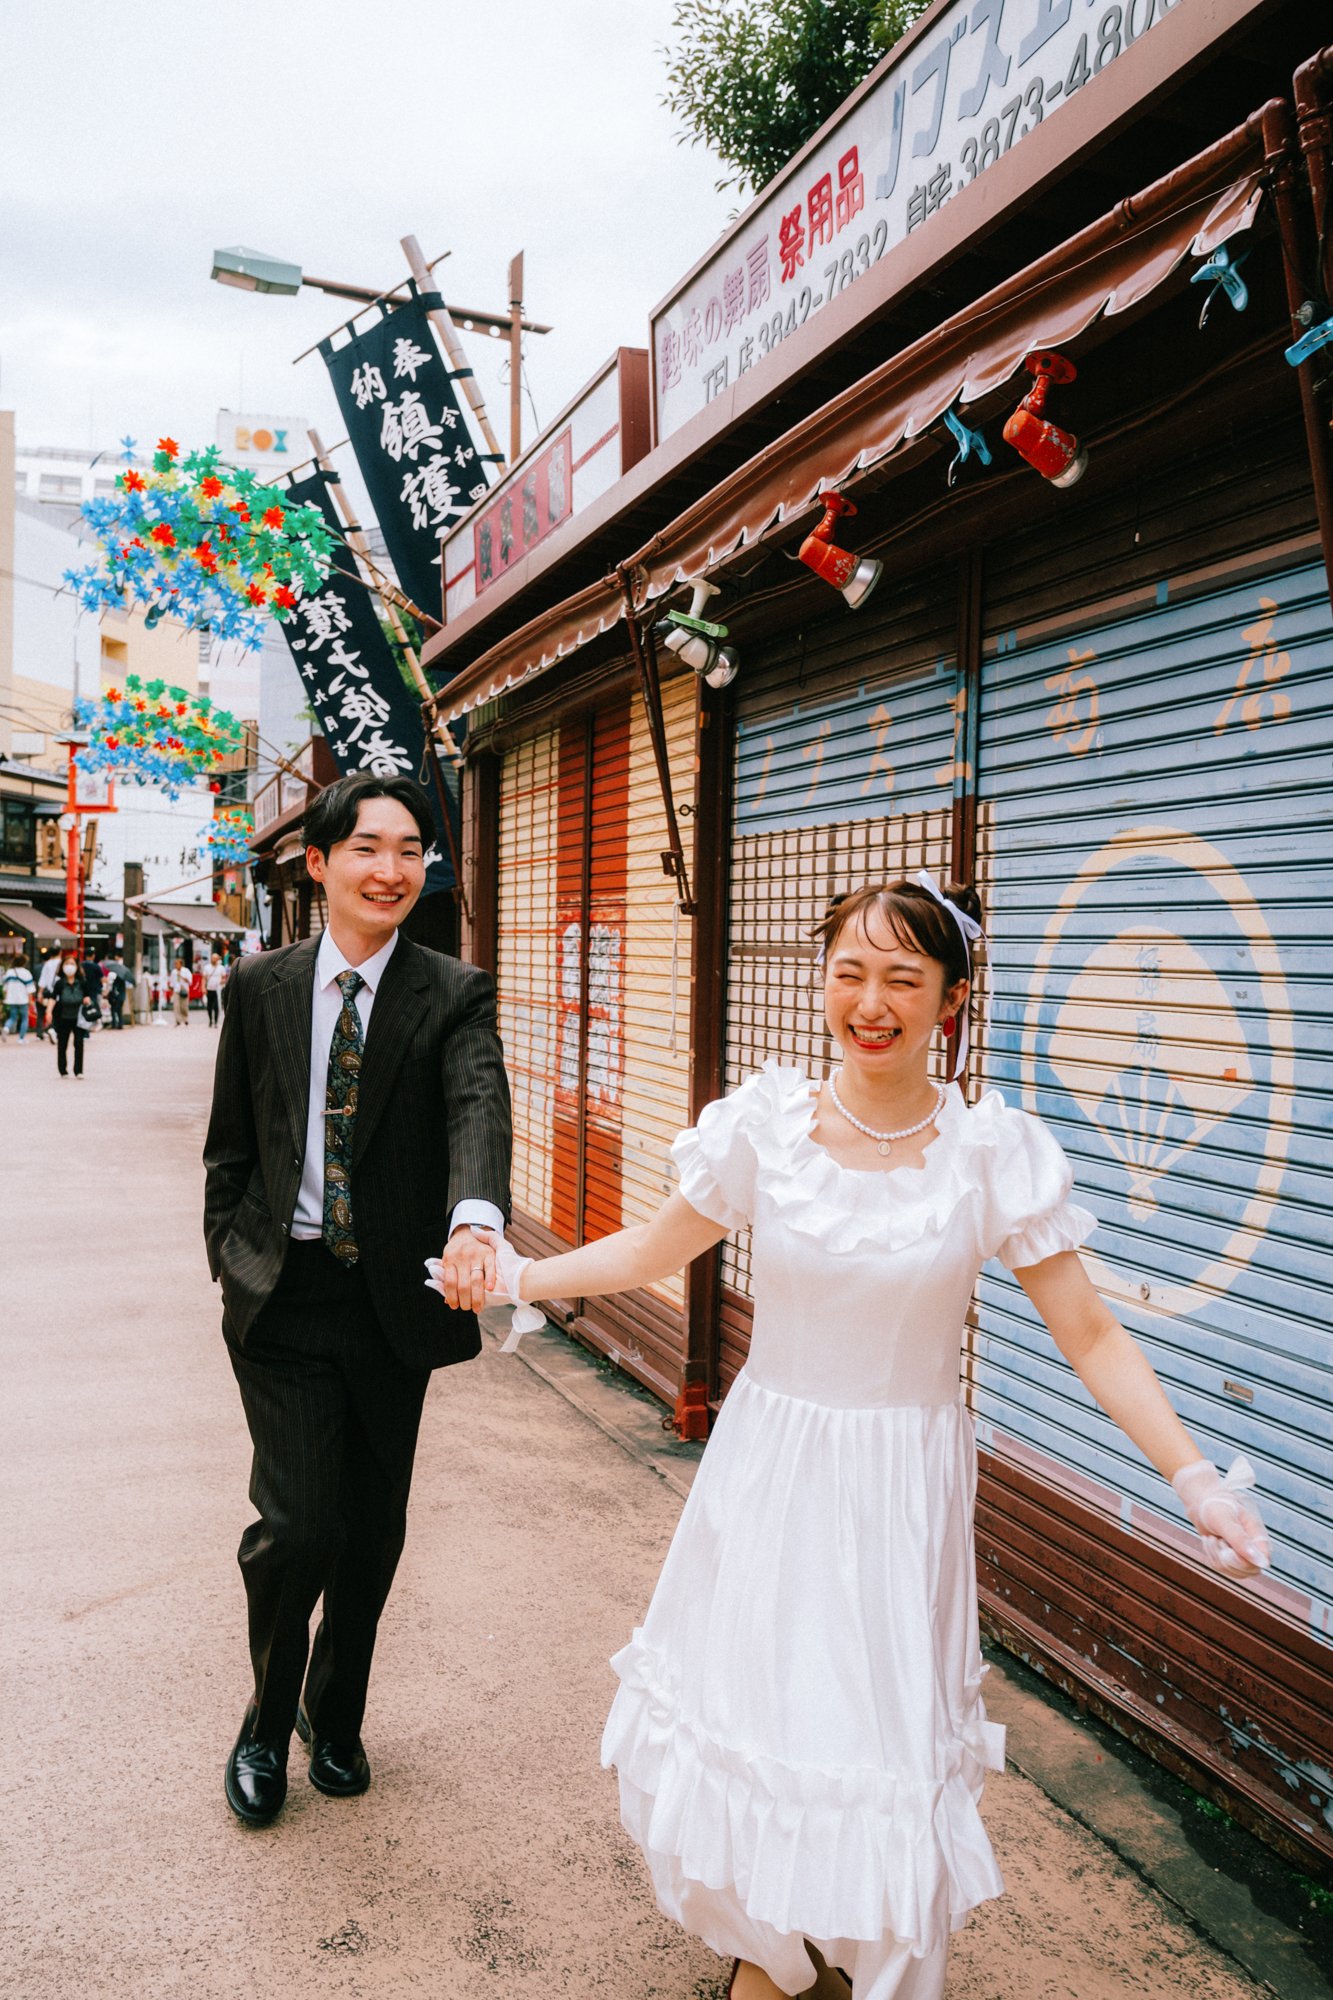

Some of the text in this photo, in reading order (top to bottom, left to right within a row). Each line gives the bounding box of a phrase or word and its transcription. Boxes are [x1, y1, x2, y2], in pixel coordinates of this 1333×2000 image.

[779, 145, 865, 284] 祭用品
[350, 338, 432, 410] 奉納
